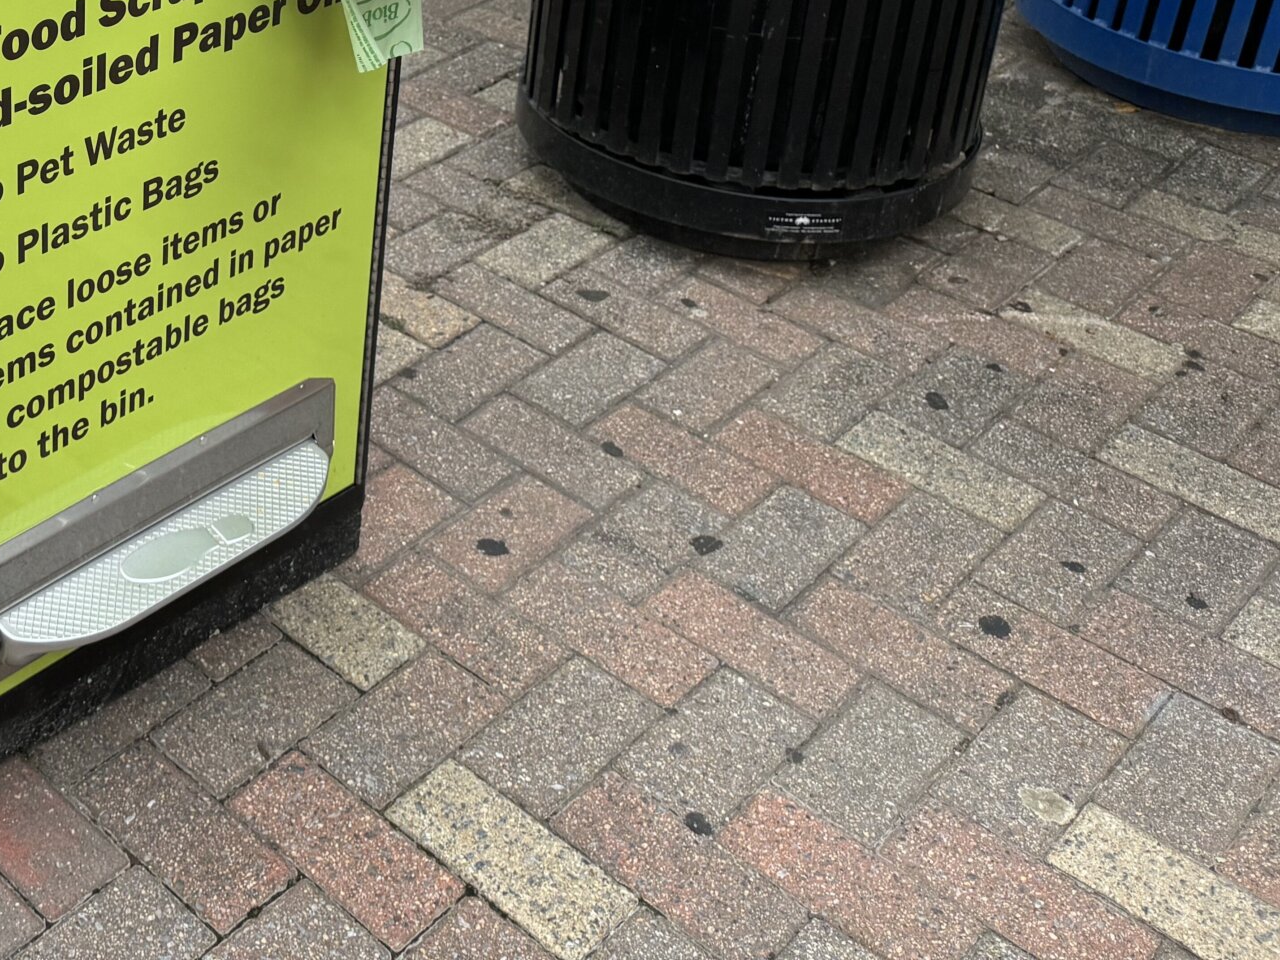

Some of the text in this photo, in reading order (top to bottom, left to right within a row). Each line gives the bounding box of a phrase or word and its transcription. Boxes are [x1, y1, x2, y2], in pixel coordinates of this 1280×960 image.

[17, 146, 74, 195] Pet
[84, 107, 187, 166] Waste
[17, 194, 132, 265] Plastic
[142, 159, 220, 211] Bags
[66, 251, 151, 309] loose
[161, 208, 244, 266] items
[252, 192, 282, 226] or
[66, 257, 220, 354] contained
[229, 248, 254, 278] in
[263, 208, 342, 268] paper
[6, 314, 209, 429] compostable
[218, 275, 286, 326] bags
[36, 416, 90, 459] the
[100, 385, 156, 428] bin.
